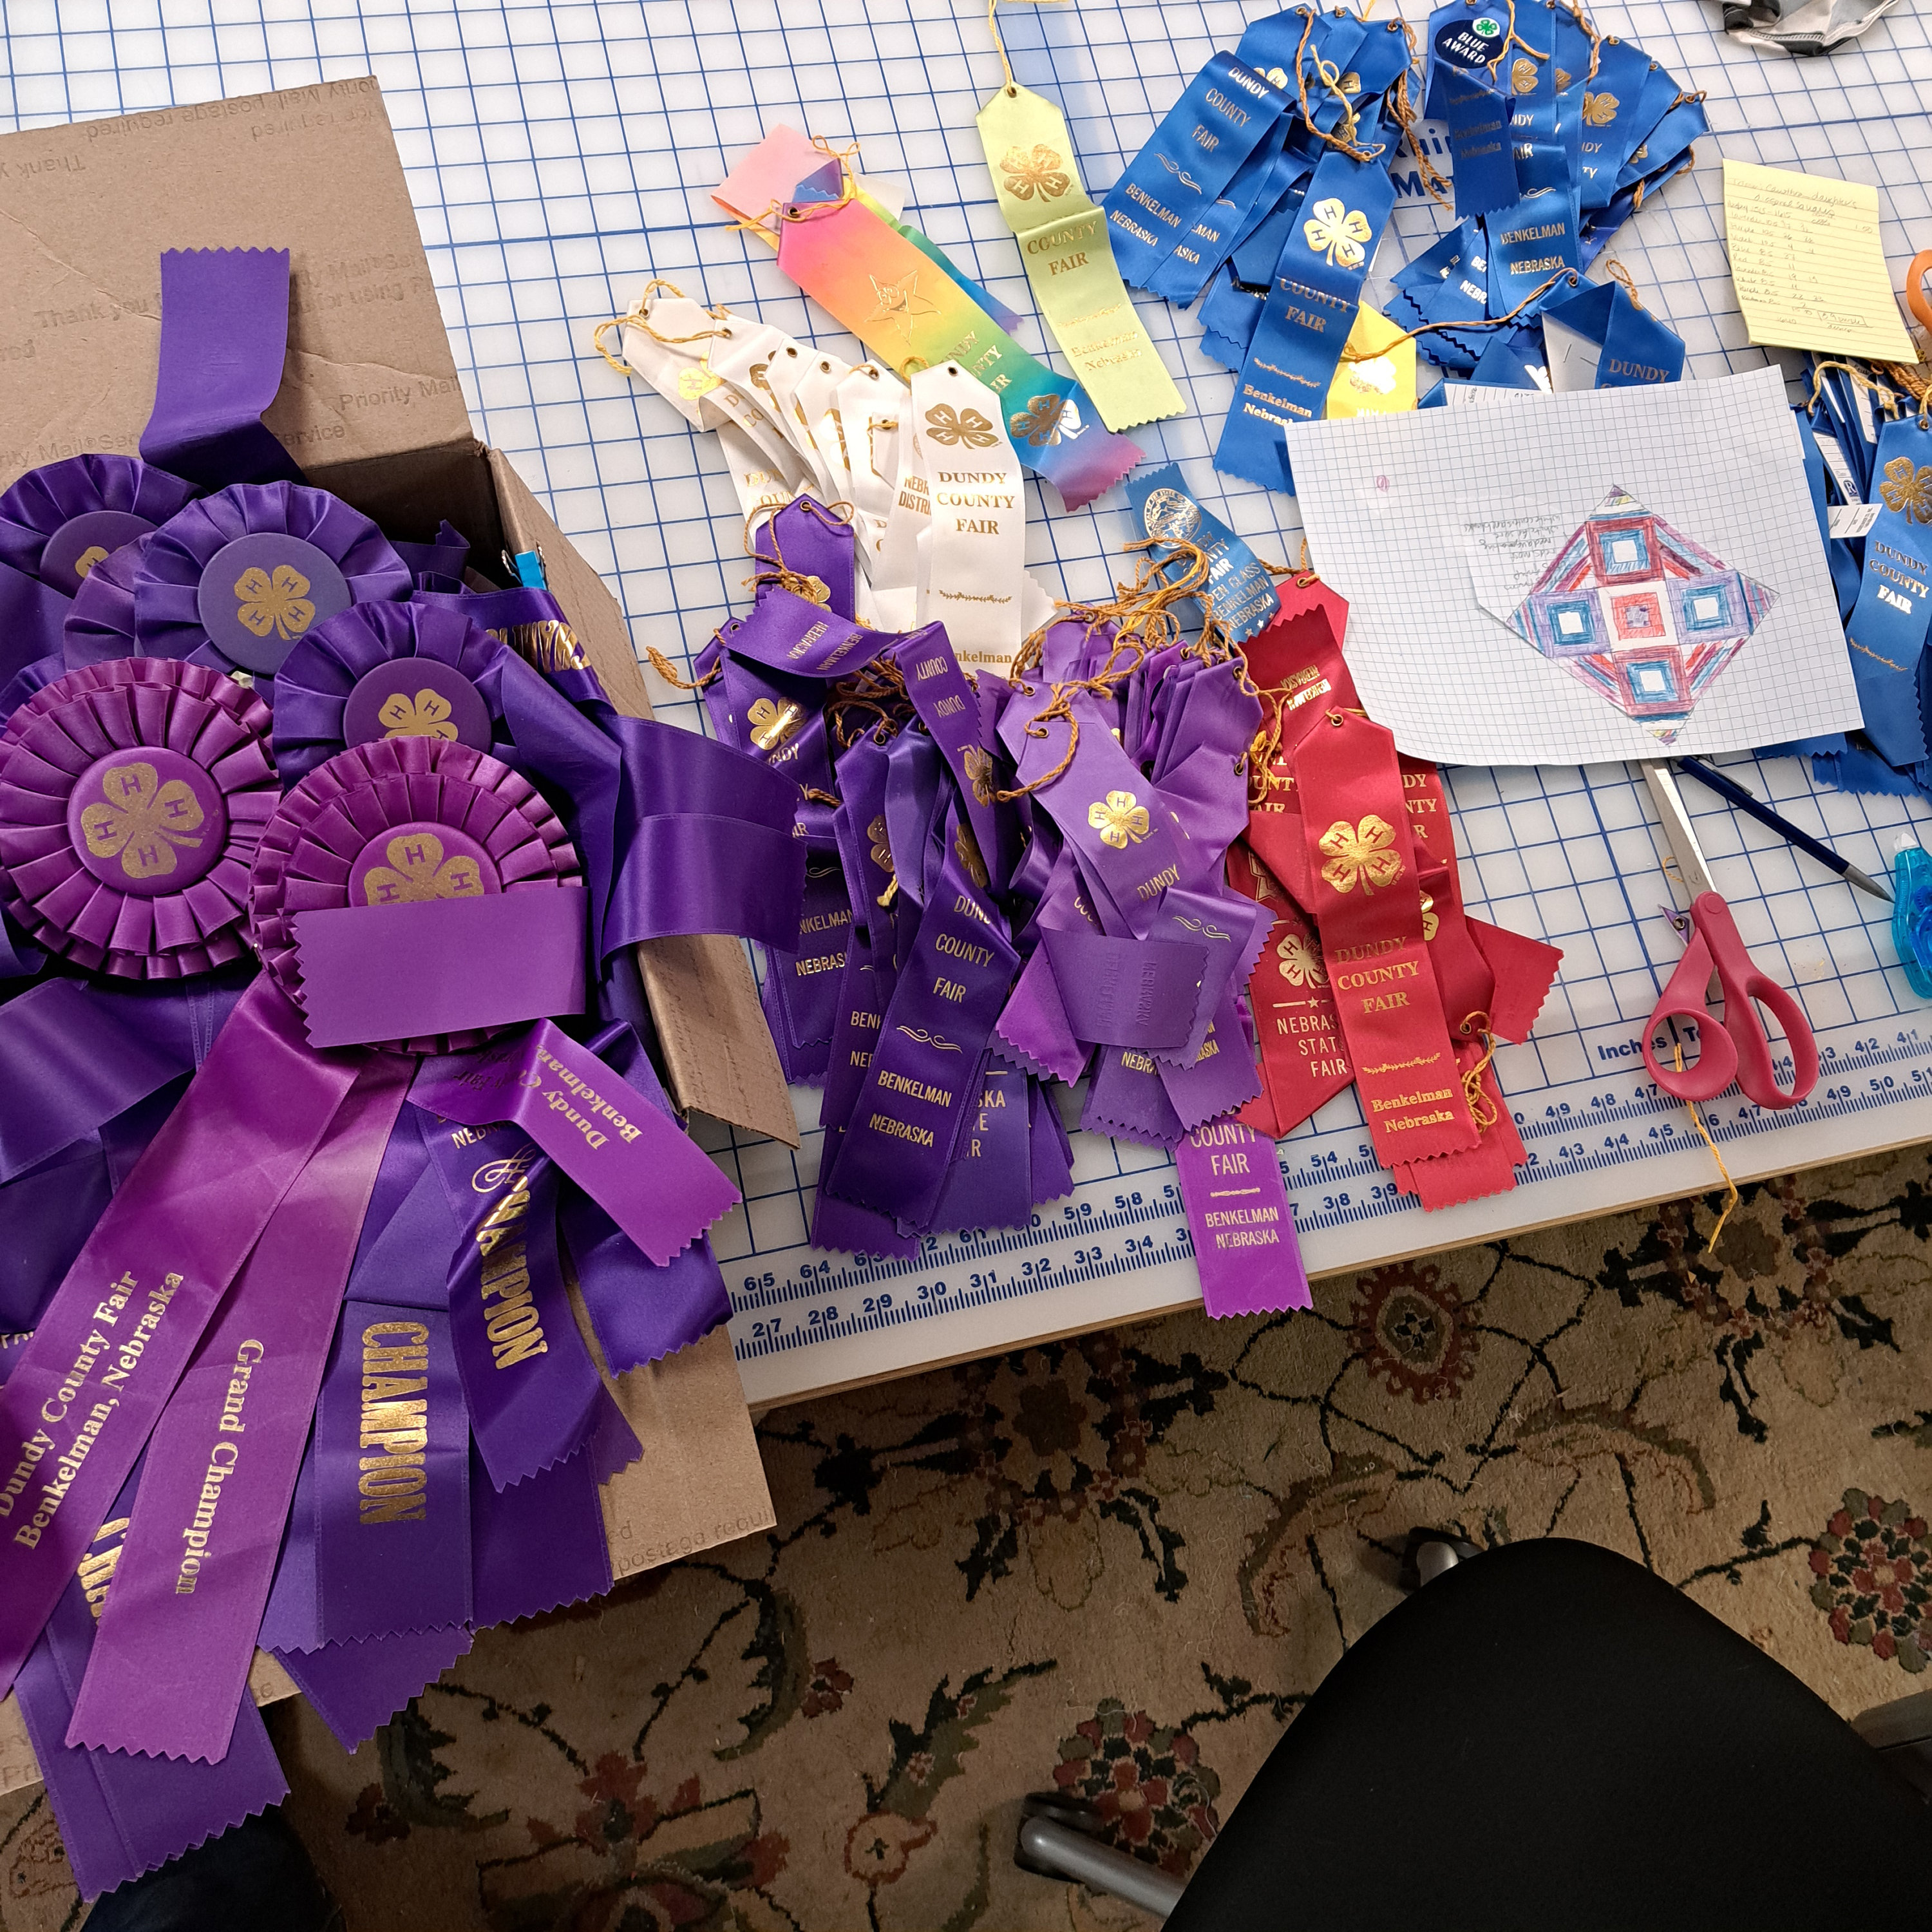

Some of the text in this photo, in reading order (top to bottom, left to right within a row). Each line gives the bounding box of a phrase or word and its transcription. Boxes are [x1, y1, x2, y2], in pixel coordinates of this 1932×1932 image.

[1442, 37, 1486, 64] AWARD
[1457, 32, 1490, 52] BLUE
[329, 80, 376, 99] iority
[1228, 66, 1270, 99] DUNDY
[1206, 88, 1251, 128] COUNTY
[1192, 124, 1220, 153] FAIR
[1125, 182, 1182, 228] BENKELMAN
[1027, 220, 1098, 256] COUNTY
[1109, 209, 1159, 247] NEBRASKA
[1500, 222, 1566, 245] BENKELMAN
[1048, 251, 1089, 277] FAIR
[1510, 255, 1566, 276] NEBRASKA
[1280, 278, 1349, 313] COUNTY
[1284, 305, 1327, 333] FAIR
[1084, 348, 1143, 372] Nebraska
[1609, 359, 1670, 384] DUNDY
[339, 386, 412, 410] Priority
[1243, 383, 1312, 418] Benkelman
[1243, 402, 1293, 426] Nebras
[278, 425, 346, 448] ervice
[937, 471, 1007, 486] DUNDY
[898, 490, 932, 516] DISTRI
[936, 491, 1016, 509] COUNTY
[955, 518, 1000, 535] FAIR
[1875, 540, 1928, 576] DUNDY
[1227, 562, 1262, 589] CLASS
[1869, 559, 1929, 600] COUNTY
[1211, 575, 1270, 621] BENKELMAN
[1227, 592, 1275, 631] NEBRASKA
[1879, 584, 1913, 615] FAIR
[786, 620, 829, 659] NEBRASKA
[815, 633, 864, 671] BENKELMAN
[915, 656, 949, 681] COUNTY
[955, 650, 1012, 664] nkelman
[933, 694, 966, 718] DUNDY
[1137, 863, 1180, 901] DUNDY
[799, 909, 853, 934] NKELMAN
[935, 933, 995, 967] COUNTY
[1335, 936, 1408, 963] DUNDY
[795, 951, 848, 977] NEBRAS
[1337, 960, 1420, 991] COUNTY
[933, 976, 967, 1003] FAIR
[1361, 991, 1411, 1014] FAIR
[1276, 1014, 1338, 1035] NEBRAS
[1311, 1058, 1348, 1077] FAIR
[536, 1043, 643, 1144] Benkelman,
[877, 1070, 952, 1108] BENKELMAN
[1370, 1087, 1454, 1113] Benkelman
[541, 1087, 610, 1151] Dundy
[869, 1112, 935, 1148] NEBRASKA
[1384, 1110, 1455, 1133] Nebraska
[1190, 1123, 1256, 1148] COUNTY
[744, 1272, 775, 1291] 65
[800, 1260, 831, 1278] 64
[1064, 1203, 1092, 1220] 59
[1115, 1192, 1143, 1209] 58
[1310, 1150, 1338, 1167] 54
[1545, 1103, 1571, 1118] 49
[1591, 1093, 1616, 1108] 48
[1634, 1083, 1658, 1099] 47
[1854, 1037, 1880, 1052] 42
[1897, 1028, 1920, 1043] 41
[1211, 1153, 1251, 1176] FAIR
[752, 1317, 782, 1338] 27
[808, 1305, 838, 1325] 28
[862, 1294, 893, 1313] 29
[916, 1281, 947, 1300] 30
[969, 1269, 998, 1288] 31
[1021, 1257, 1052, 1276] 32
[1074, 1246, 1103, 1264] 33
[1124, 1235, 1154, 1253] 34
[1322, 1192, 1350, 1209] 38
[1370, 1182, 1397, 1200] 39
[1558, 1142, 1584, 1159] 43
[1604, 1133, 1629, 1149] 44
[1647, 1123, 1674, 1139] 45
[1826, 1085, 1852, 1101] 49
[1870, 1075, 1895, 1092] 50
[1206, 1206, 1279, 1228] BENKELMAN
[1216, 1228, 1280, 1249] NEBRASKA
[0, 1270, 139, 1518] Dundy County Fair
[219, 1338, 265, 1434] Grand
[14, 1397, 122, 1550] Benkelman,
[101, 1271, 185, 1393] Nebraska
[358, 1320, 430, 1526] CHAMPION
[175, 1440, 240, 1595] Champion
[618, 1531, 705, 1576] postage
[714, 1507, 773, 1540] requi
